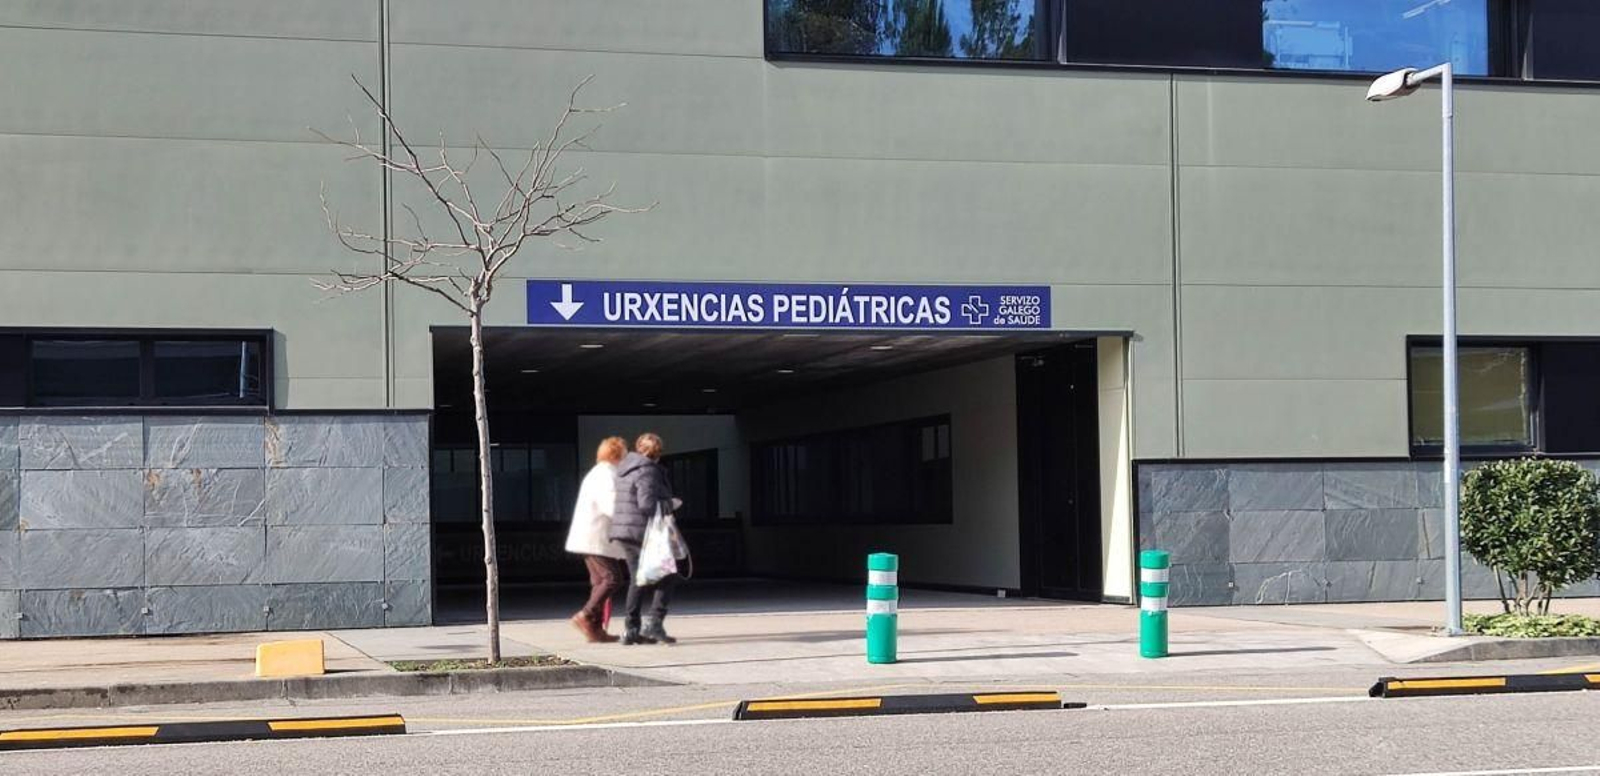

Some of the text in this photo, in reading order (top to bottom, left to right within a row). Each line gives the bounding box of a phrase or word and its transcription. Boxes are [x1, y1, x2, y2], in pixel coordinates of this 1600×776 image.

[1000, 295, 1041, 305] SERVIZO
[603, 287, 951, 325] URXENCIAS PEDIÁTRICAS
[998, 305, 1041, 315] GALEGO
[993, 314, 1006, 325] de
[460, 543, 563, 561] URENCIAS
